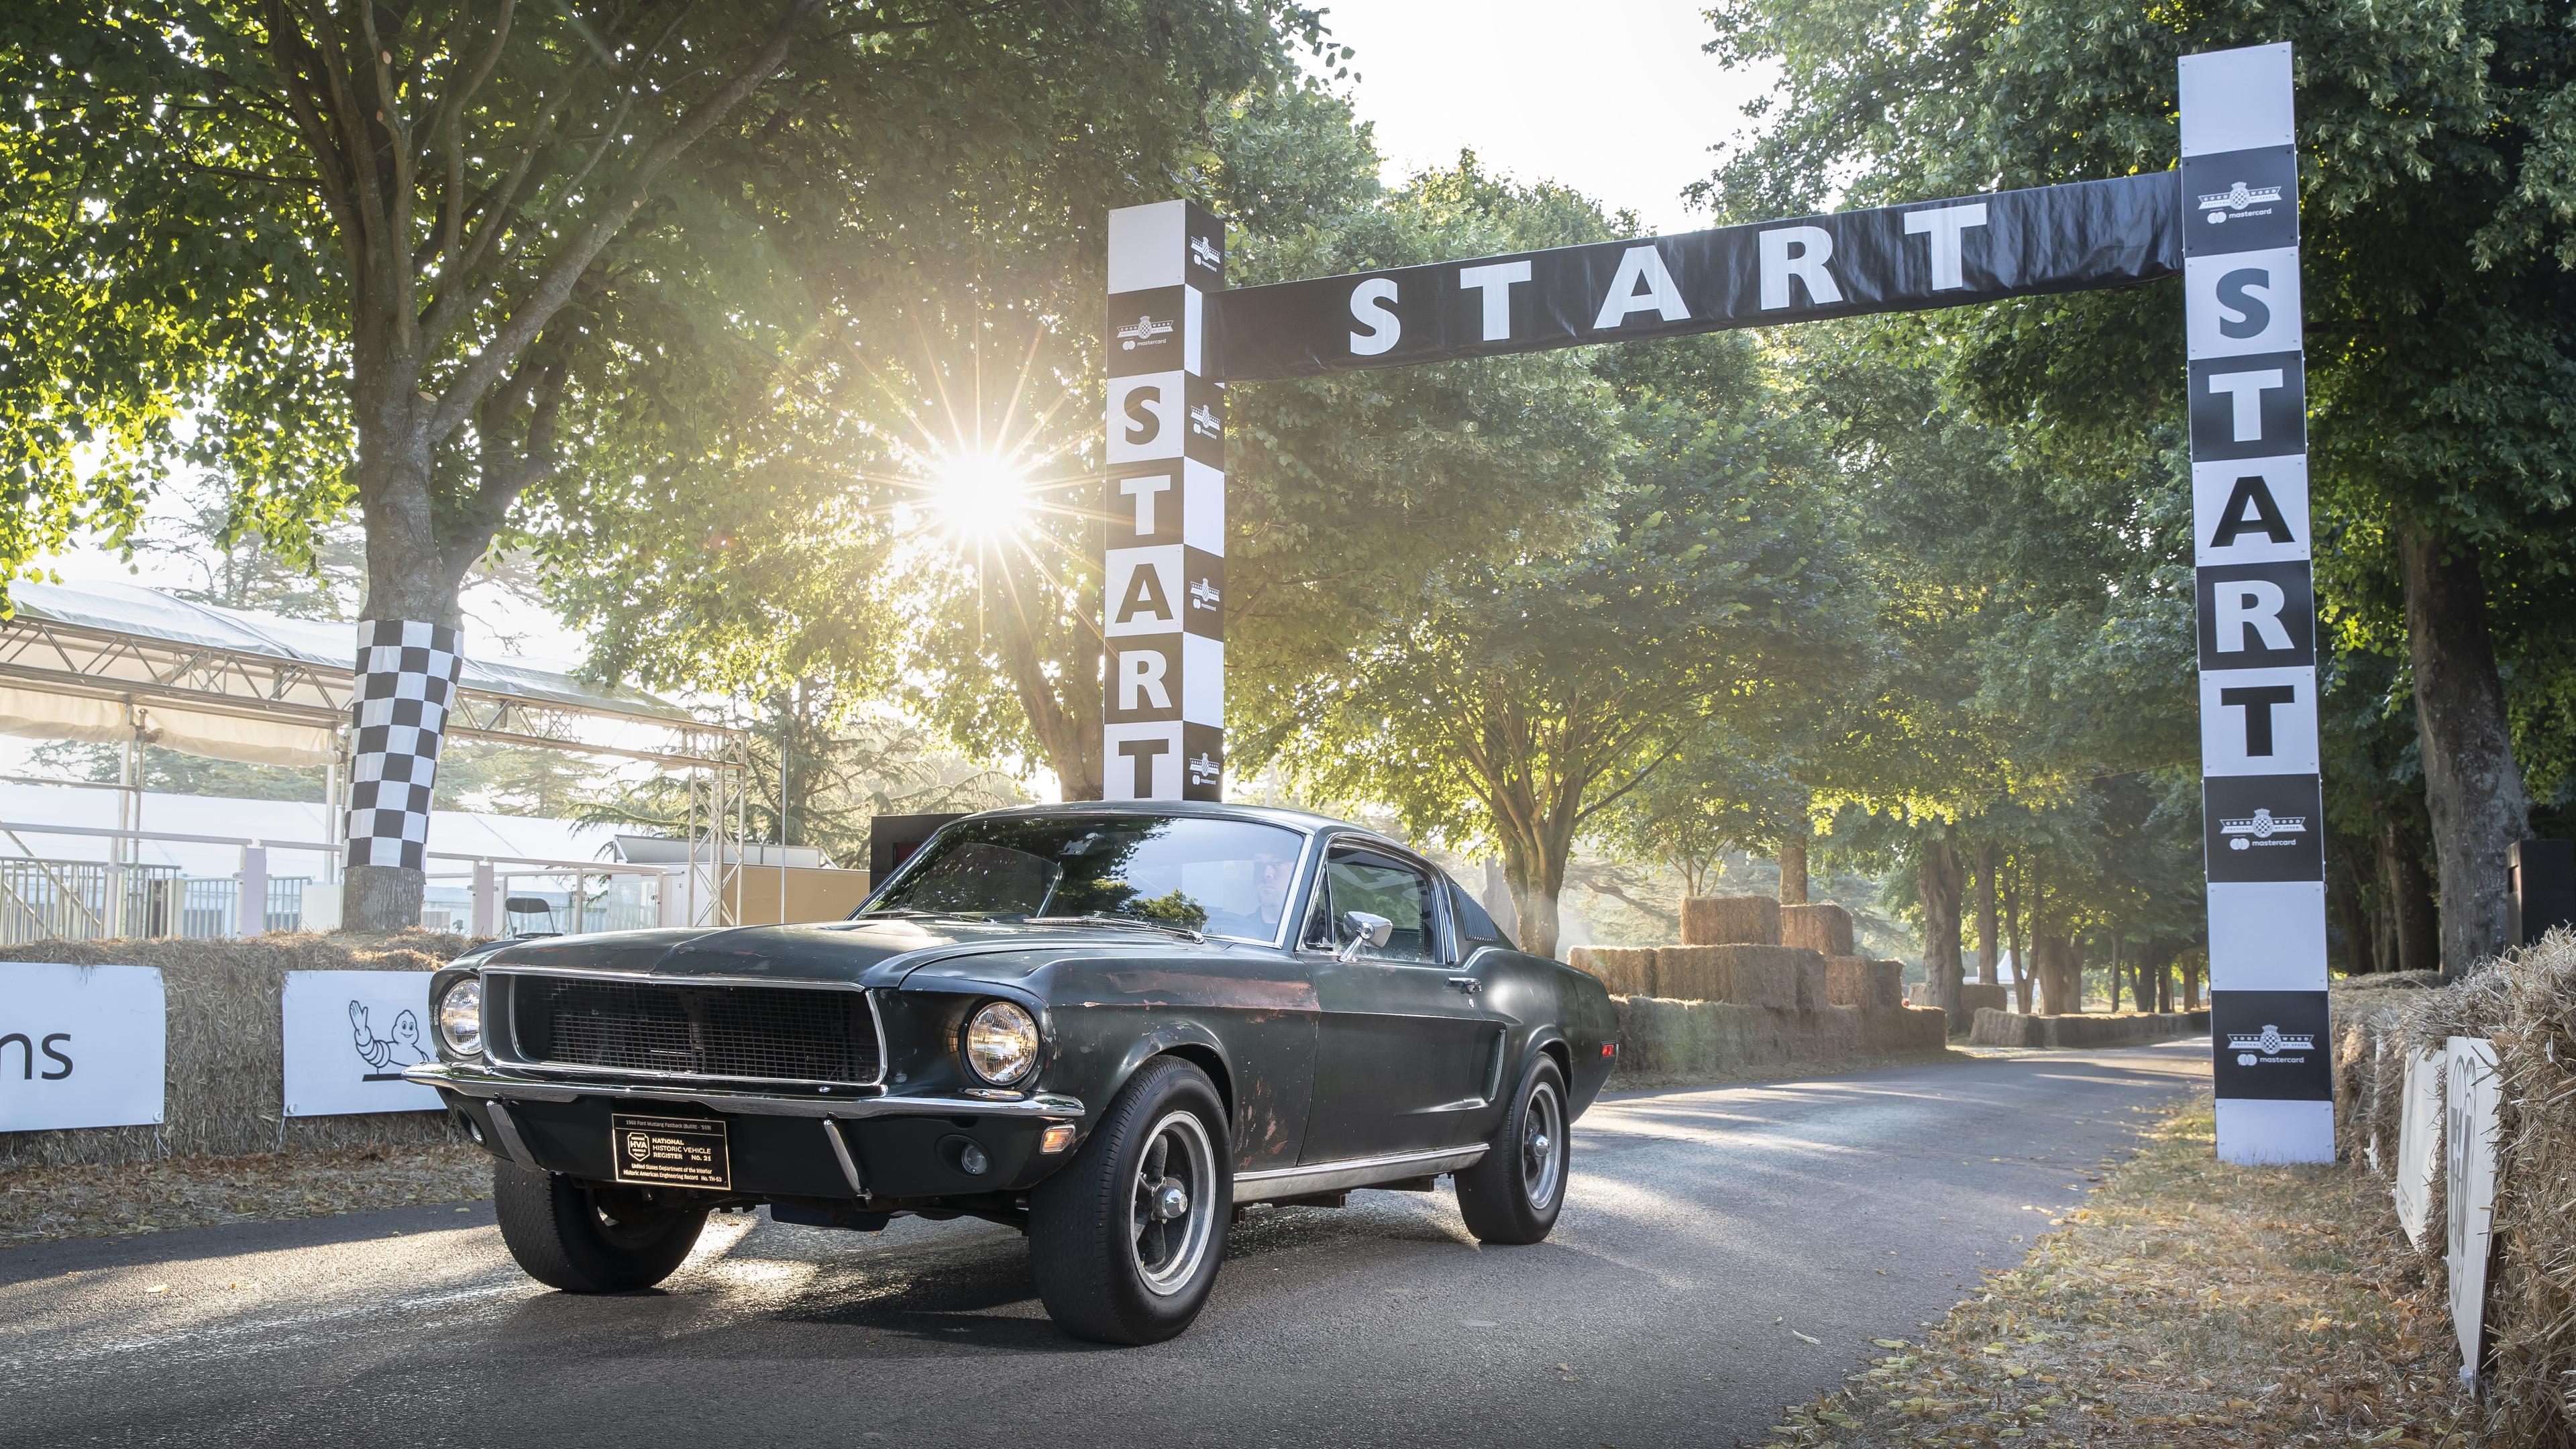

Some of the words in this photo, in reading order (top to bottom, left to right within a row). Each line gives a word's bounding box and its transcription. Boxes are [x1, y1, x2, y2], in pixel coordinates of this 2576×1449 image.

[2229, 208, 2271, 219] mastercard
[1349, 203, 1987, 356] START
[1137, 338, 1167, 346] mastercard
[2208, 268, 2296, 757] START
[1115, 386, 1174, 798] START
[630, 1140, 647, 1148] HVA
[653, 1144, 682, 1152] HISTORIC
[659, 1172, 684, 1180] Engineering
